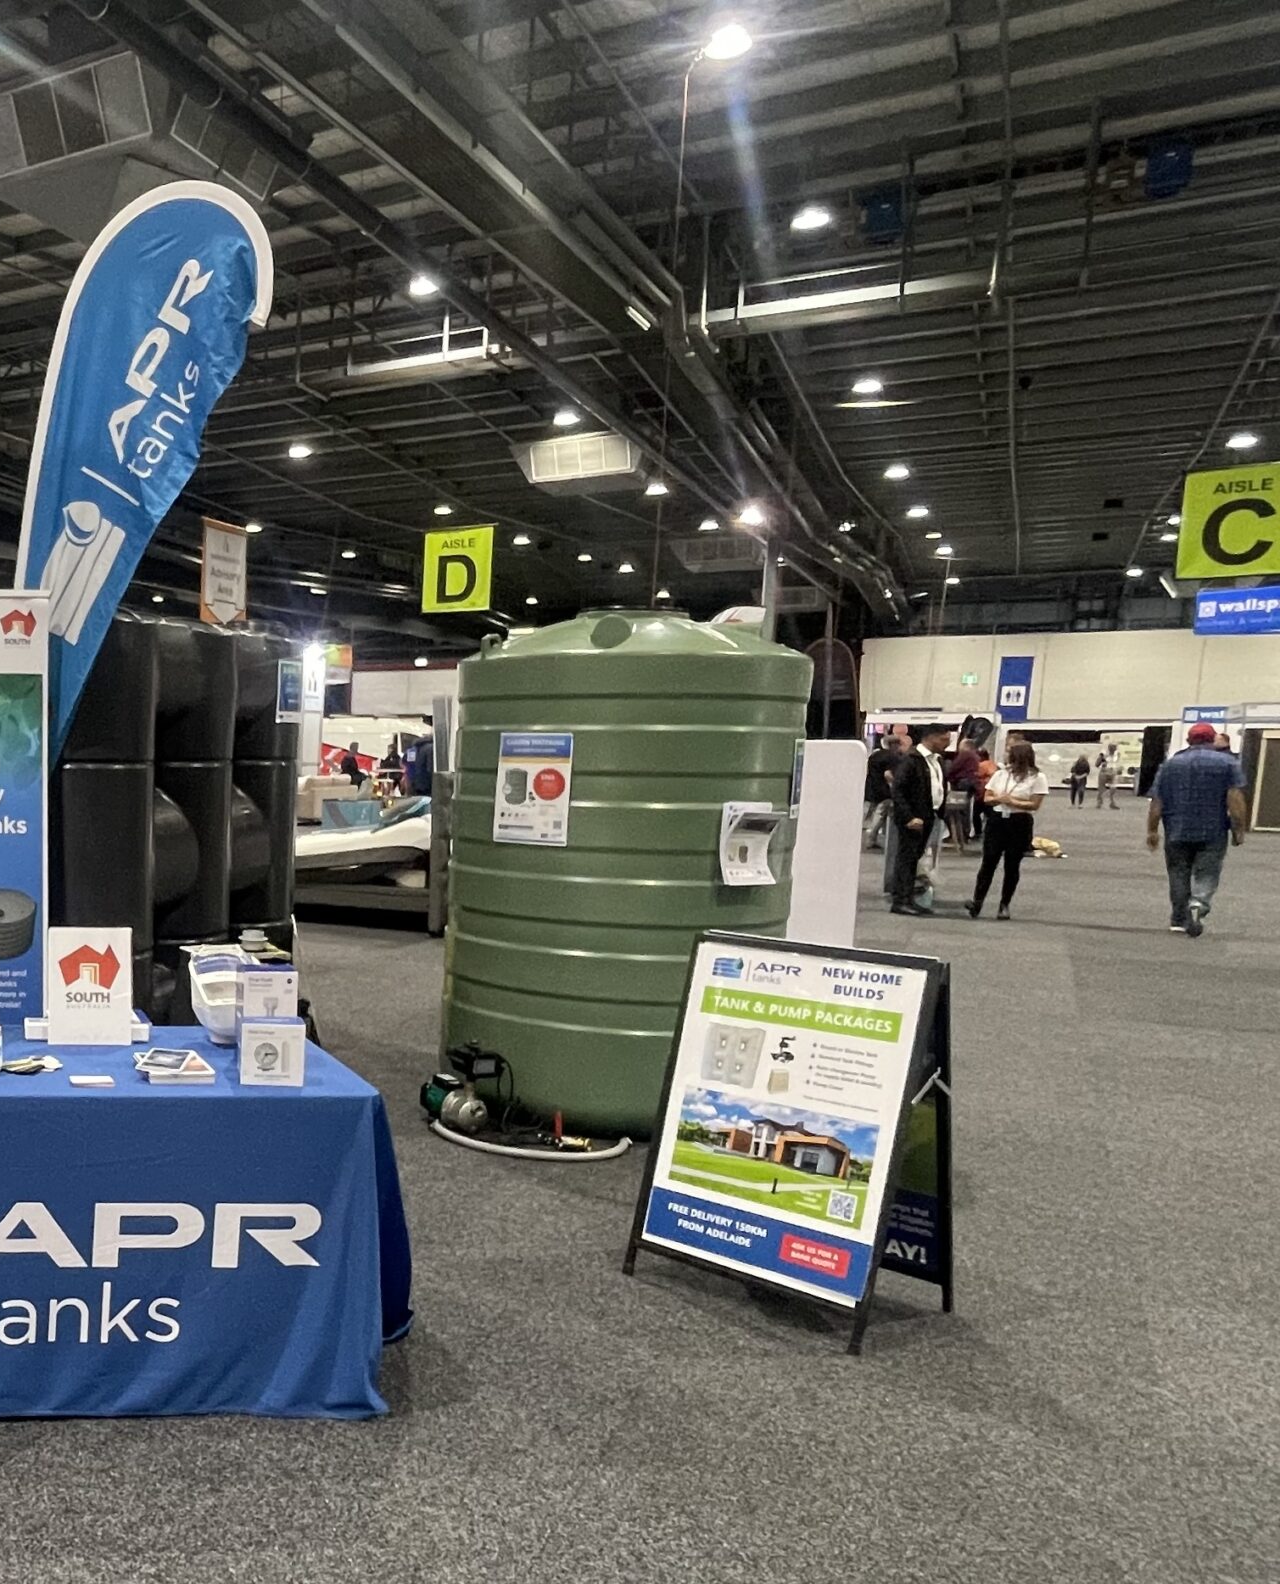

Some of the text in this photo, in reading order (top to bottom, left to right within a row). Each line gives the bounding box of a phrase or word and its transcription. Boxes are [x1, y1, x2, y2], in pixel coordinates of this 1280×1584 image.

[107, 258, 214, 465] APR
[127, 359, 201, 480] tanks
[1212, 477, 1275, 495] AISLE
[1201, 497, 1277, 566] C
[441, 537, 476, 550] AISLE
[435, 554, 477, 604] D
[1218, 598, 1280, 613] wallsp
[4, 638, 32, 646] SOUTH
[751, 973, 782, 986] tanks
[753, 962, 803, 978] APR
[822, 966, 903, 987] NEW HOME
[65, 991, 111, 1003] SOUTH
[833, 984, 885, 1001] BUILDS
[713, 995, 893, 1034] TANK & PUMP PACKAGES
[667, 1202, 768, 1238] FREE DELIVERY 150KM
[677, 1218, 752, 1248] FROM ADELAIDE
